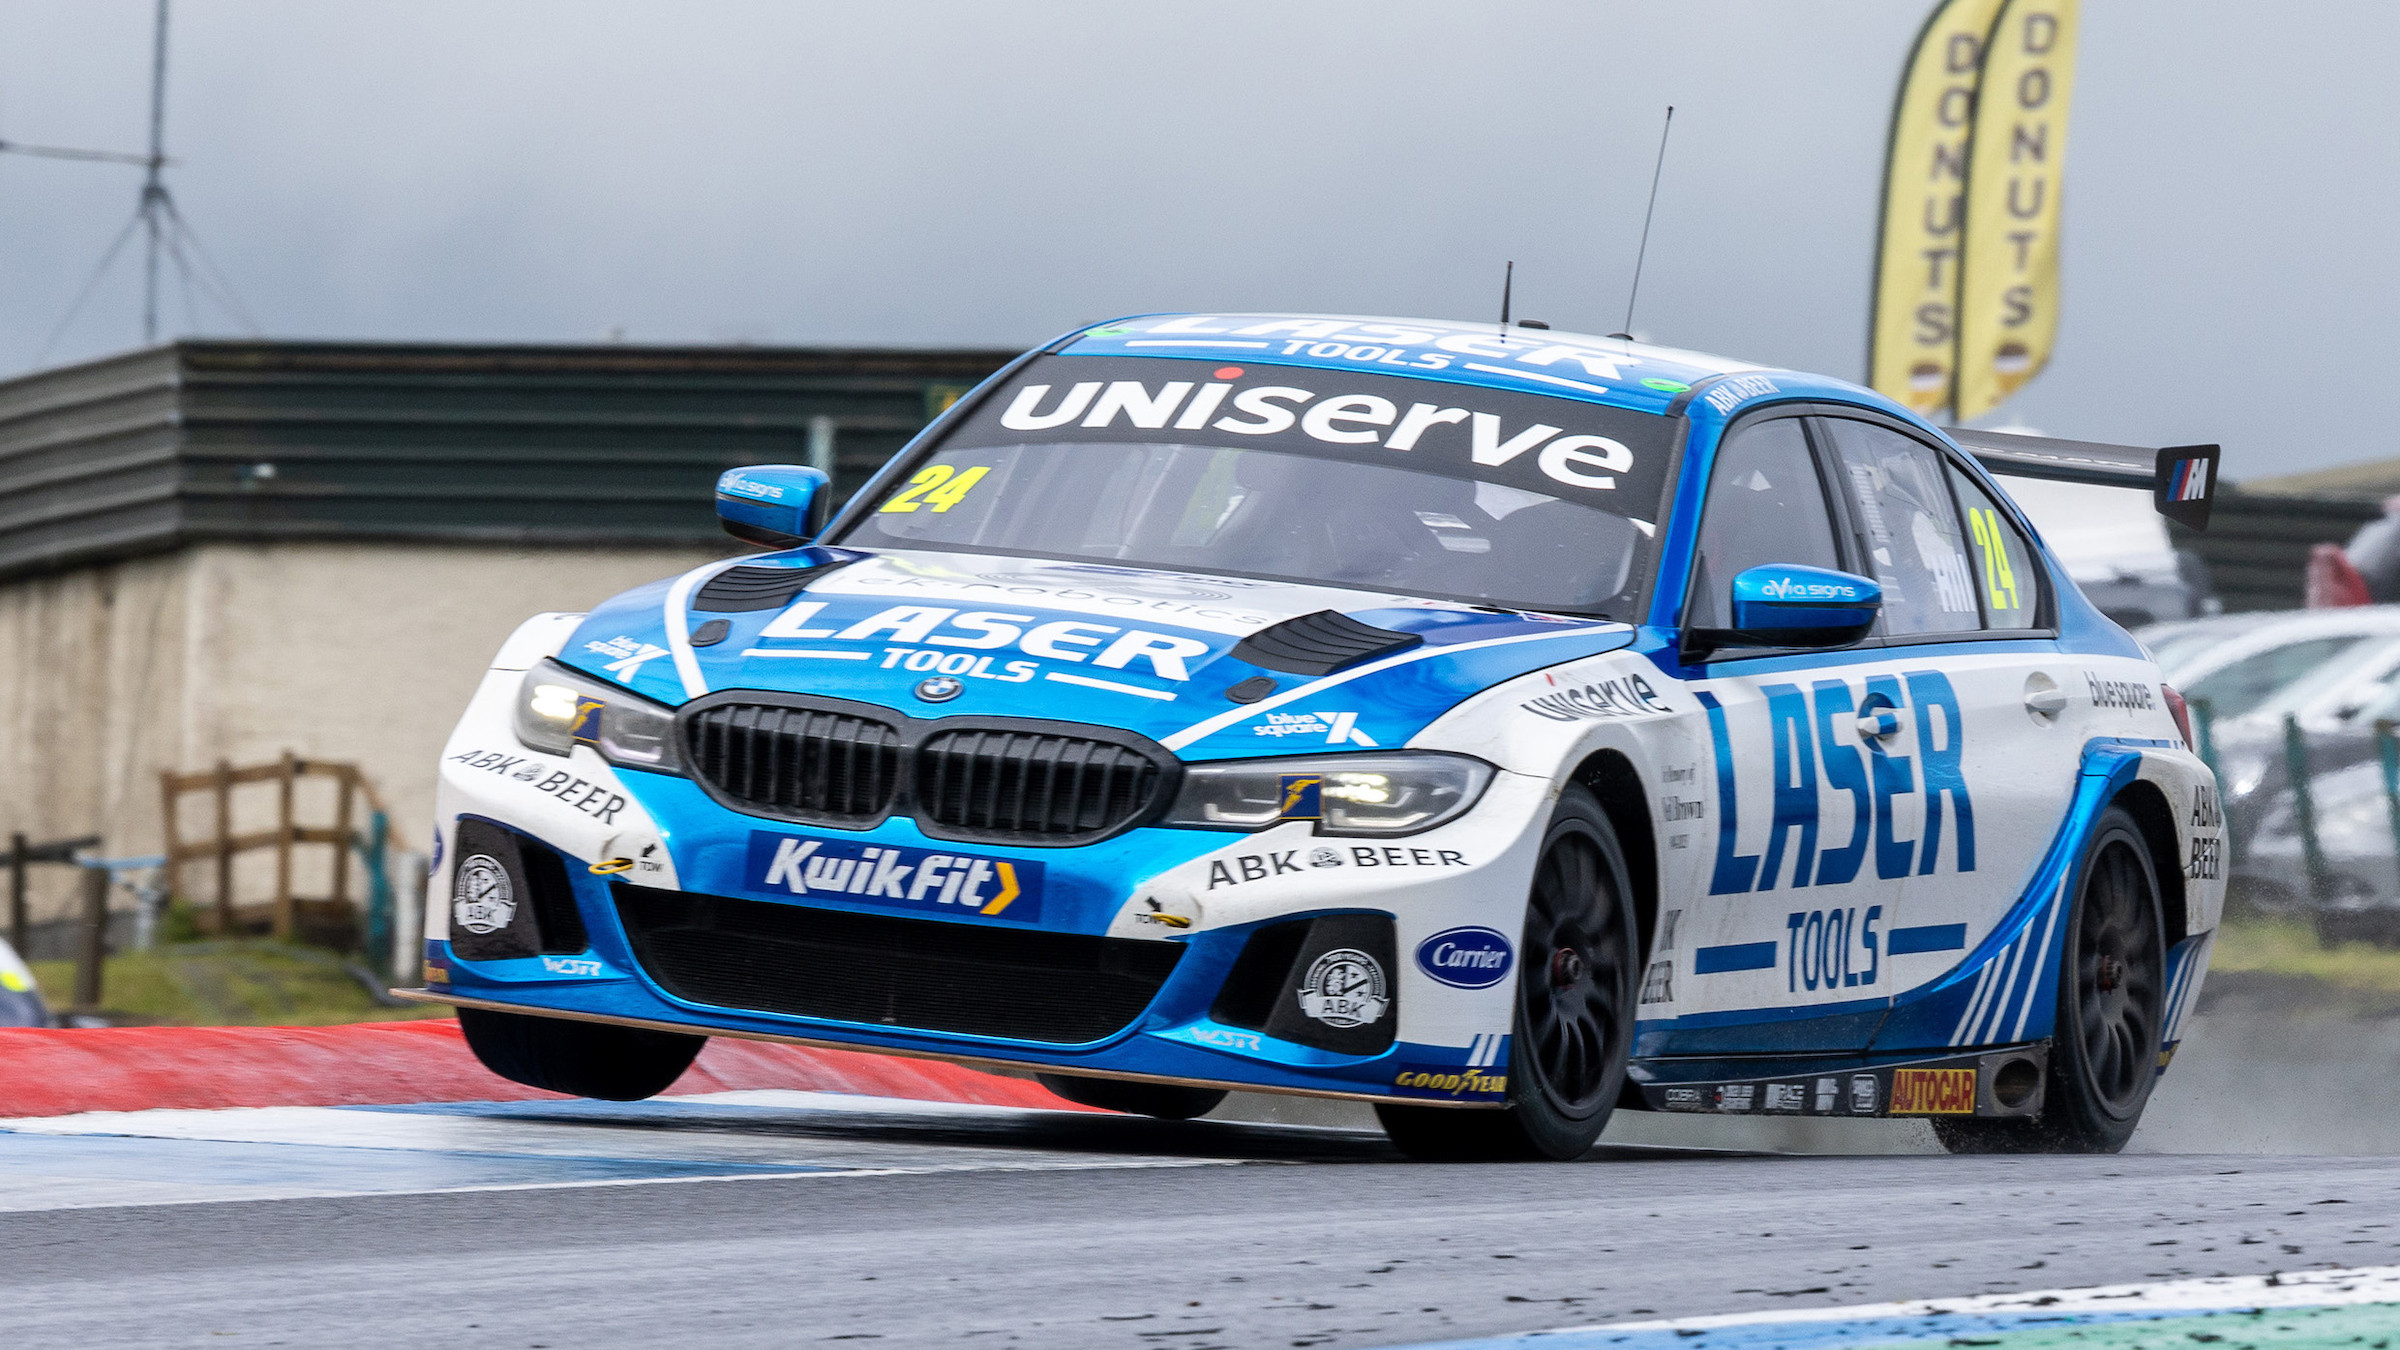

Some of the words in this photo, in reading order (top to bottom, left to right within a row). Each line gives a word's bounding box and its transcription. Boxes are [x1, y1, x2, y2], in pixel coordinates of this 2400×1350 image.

[2002, 12, 2058, 328] DONUTS
[1146, 315, 1643, 380] LASER
[1281, 339, 1456, 371] TOOLS
[880, 465, 991, 512] 24
[1968, 506, 2020, 610] 24
[759, 600, 1211, 682] LASER
[880, 647, 1041, 683] TOOLS
[1252, 722, 1329, 737] square
[1265, 712, 1317, 725] blue
[447, 749, 523, 779] ABK
[534, 770, 628, 827] BEER
[1693, 668, 1976, 897] LASER
[1207, 848, 1306, 890] ABK
[1352, 846, 1472, 868] BEER
[1431, 941, 1507, 969] Carrier
[1787, 904, 1883, 993] TOOLS
[1321, 999, 1367, 1018] ABK
[1892, 1069, 1974, 1113] AUTOCAR
